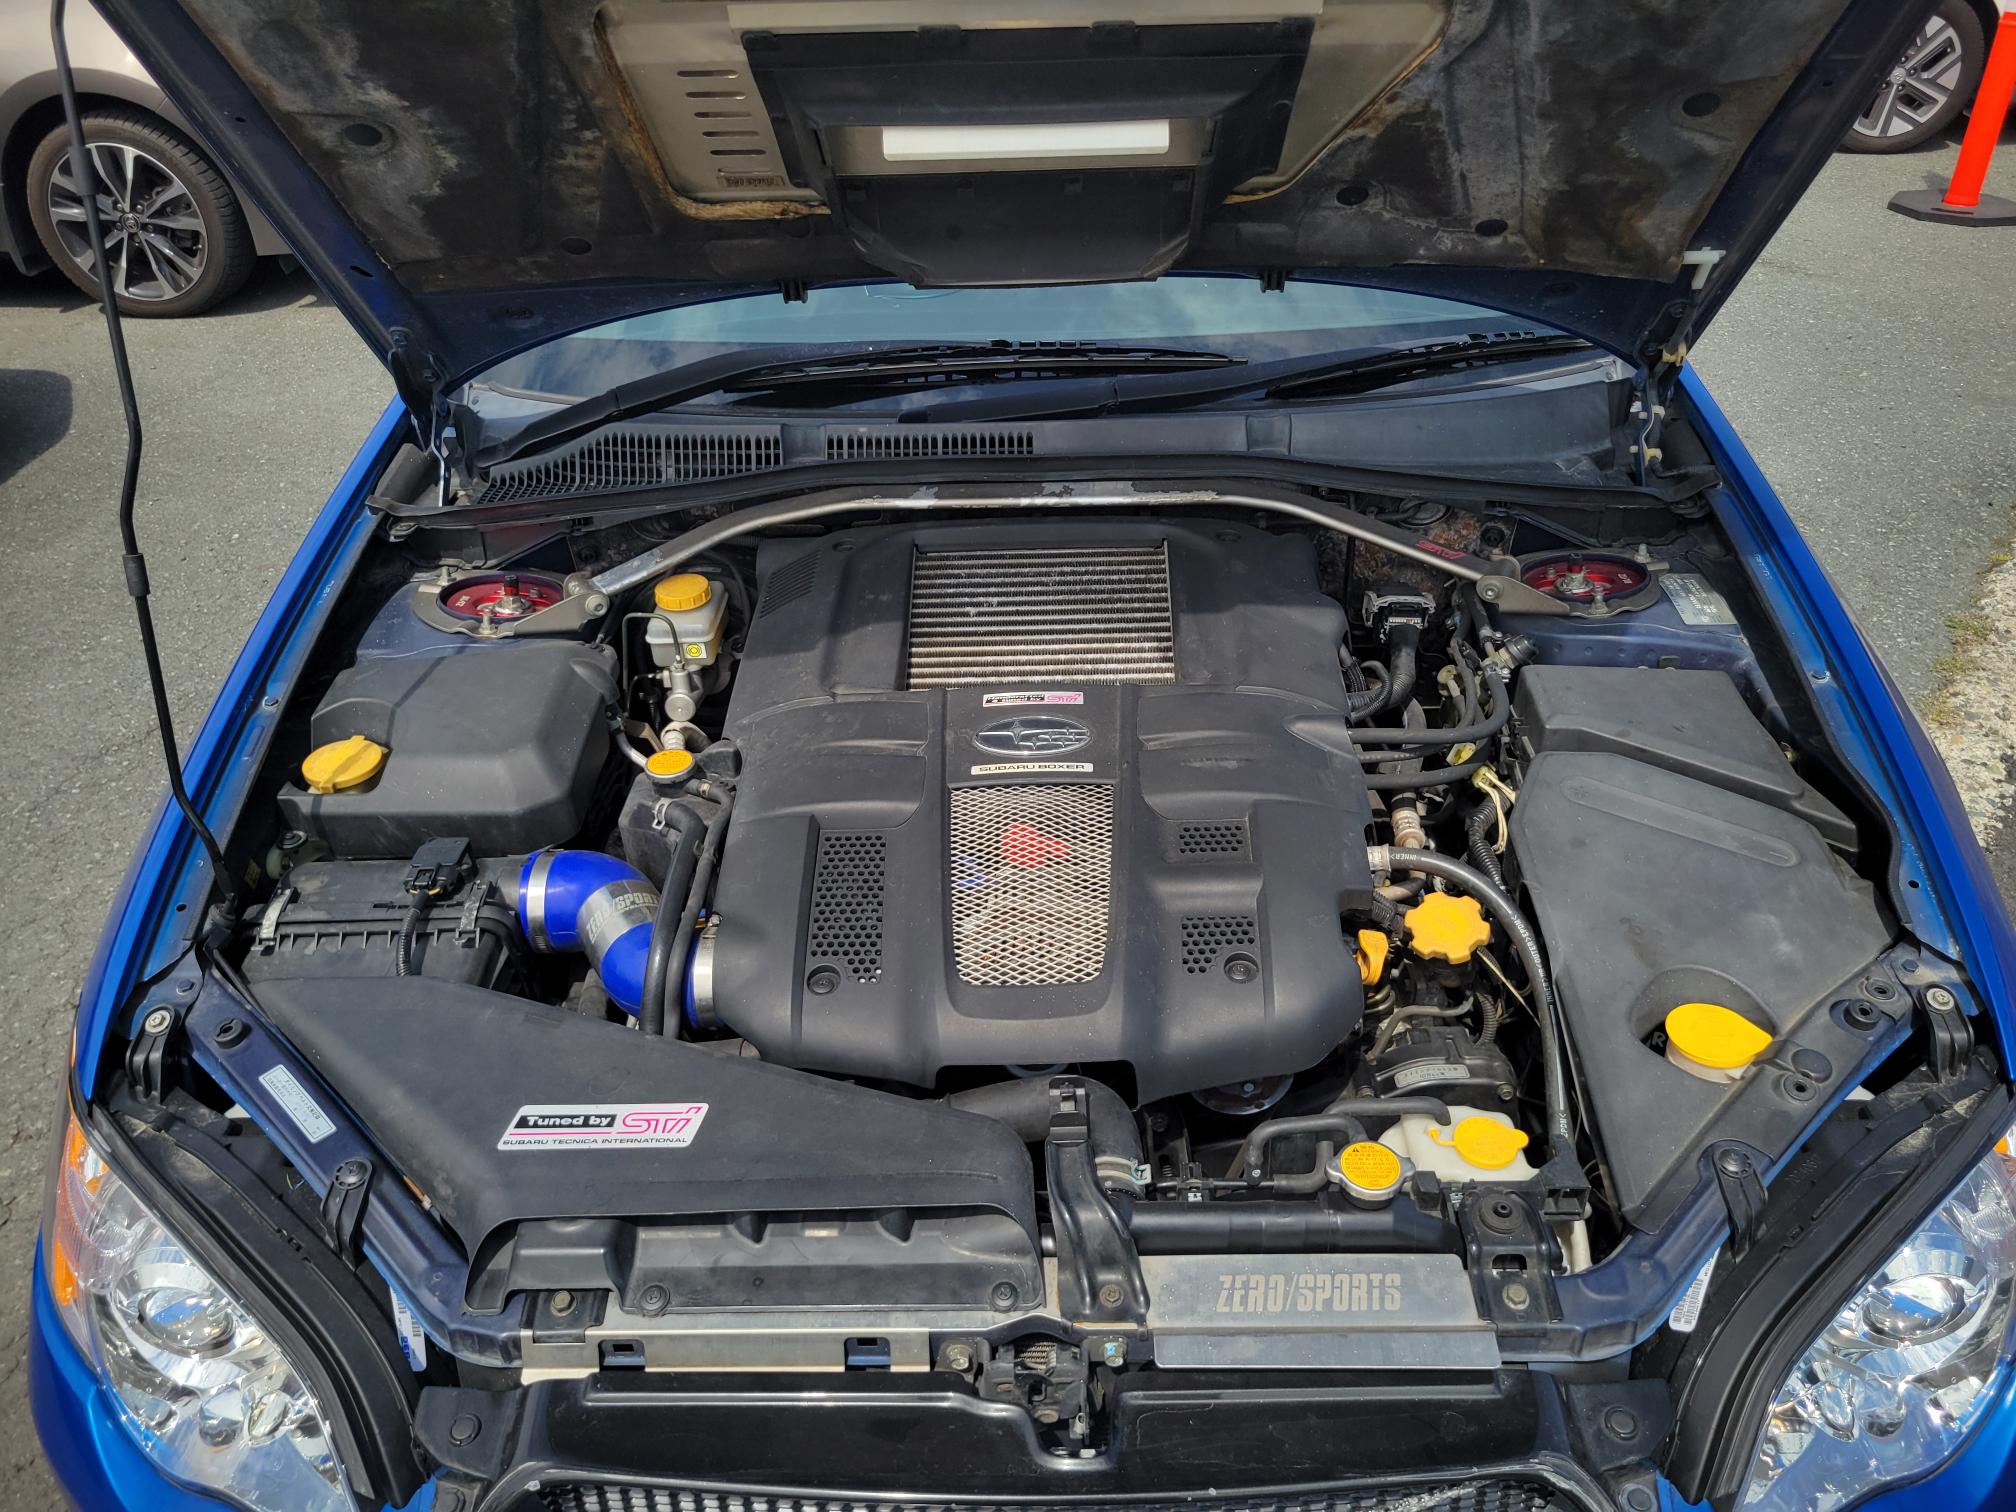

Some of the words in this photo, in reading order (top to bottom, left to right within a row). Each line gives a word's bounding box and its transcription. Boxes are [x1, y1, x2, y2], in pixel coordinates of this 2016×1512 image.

[979, 764, 1035, 772] SUBARU
[526, 1115, 585, 1127] Tuned
[588, 1115, 612, 1128] by
[601, 1137, 688, 1145] INTERNATIONAL
[1216, 1272, 1401, 1313] ZERO/SPORTS
